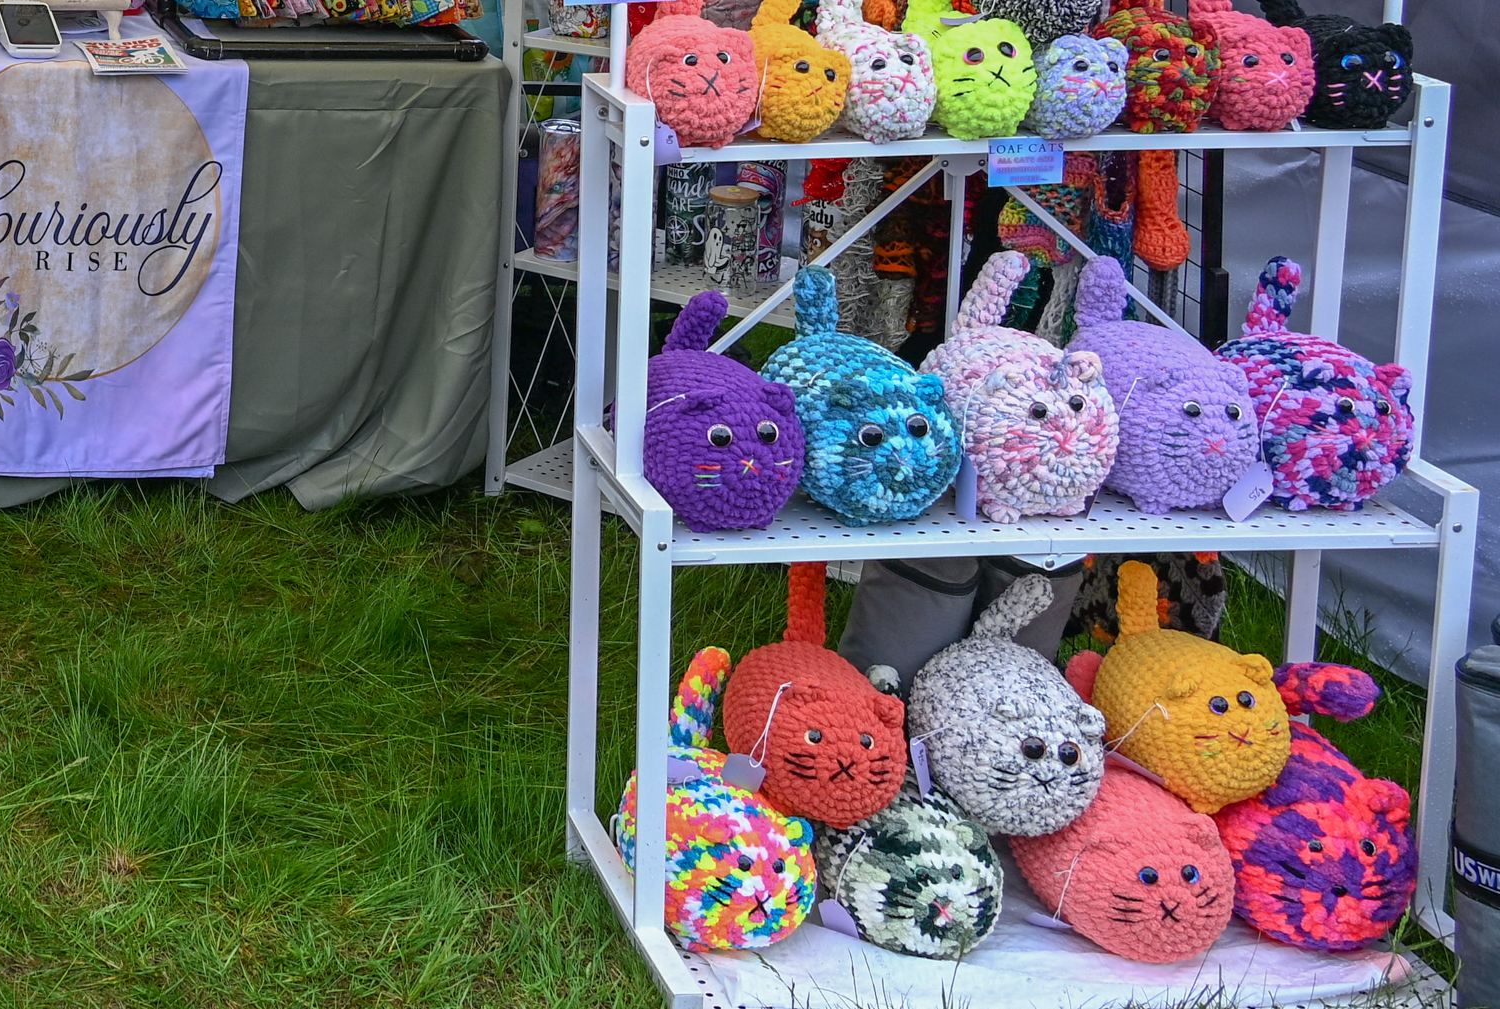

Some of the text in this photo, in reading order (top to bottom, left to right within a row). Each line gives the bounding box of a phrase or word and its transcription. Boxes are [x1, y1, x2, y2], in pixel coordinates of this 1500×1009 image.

[989, 143, 1064, 154] LOAF CATS
[671, 198, 694, 212] ARE
[35, 250, 128, 272] RISE
[1453, 846, 1478, 883] US
